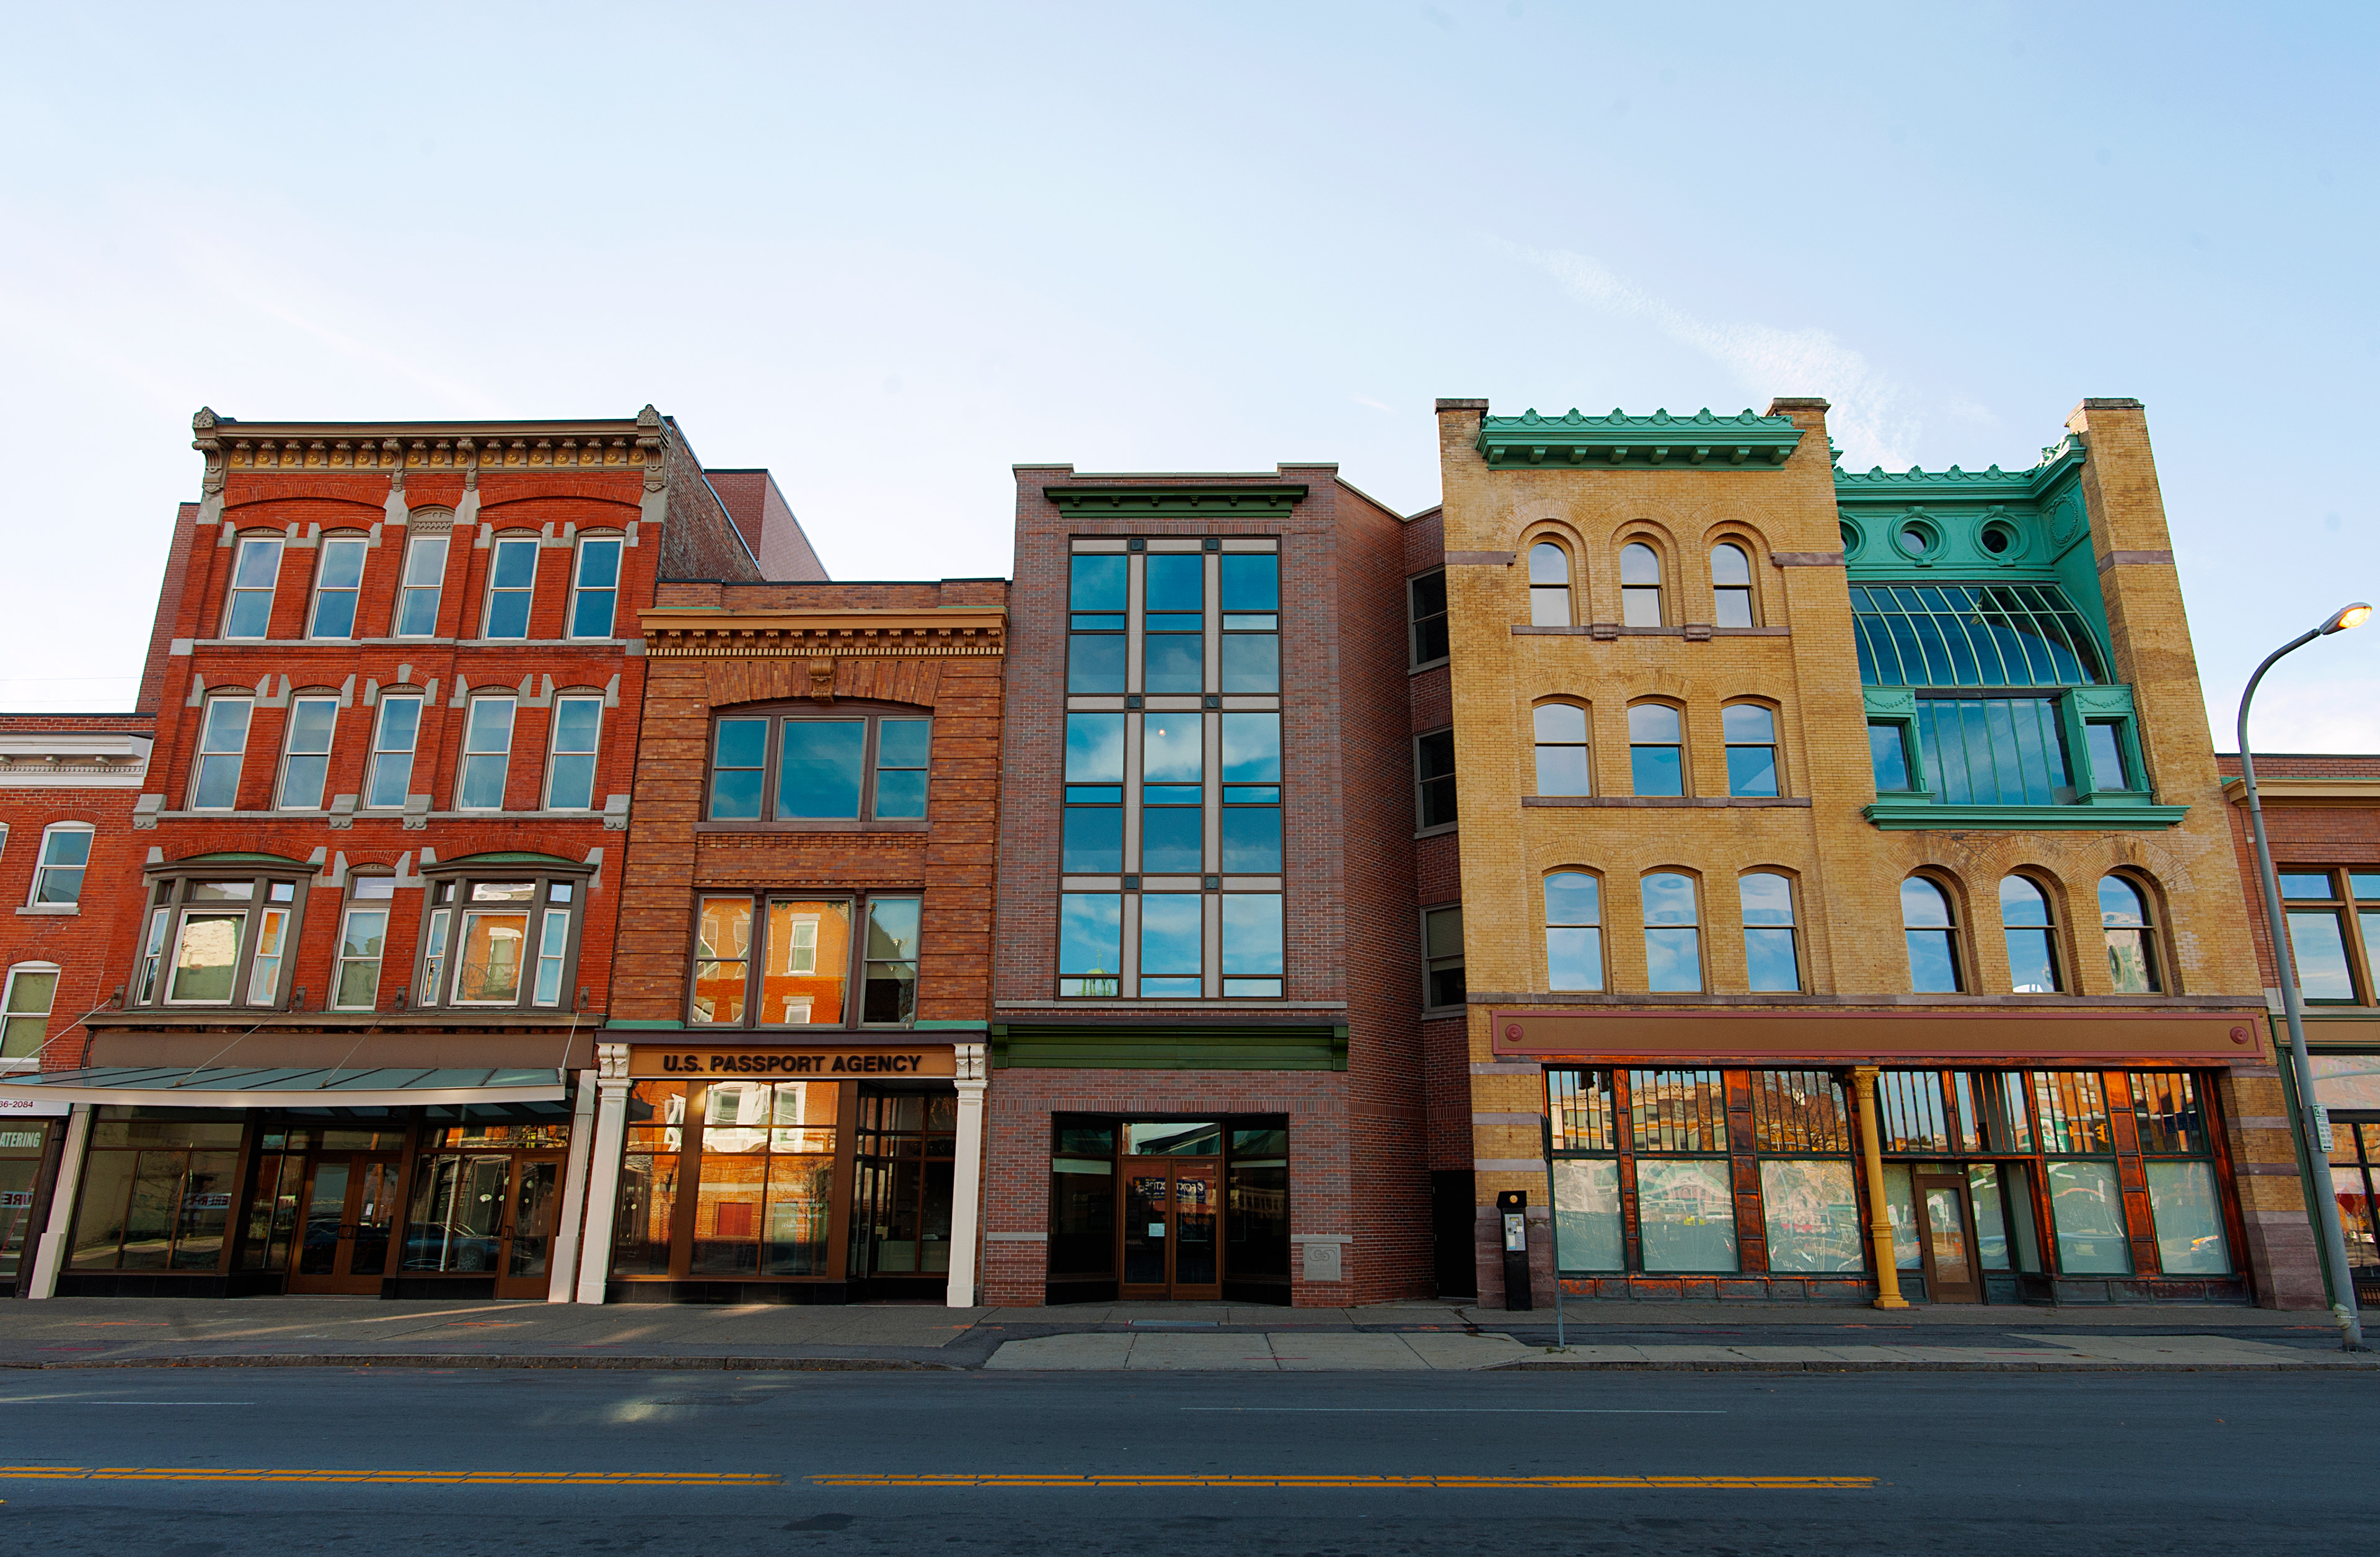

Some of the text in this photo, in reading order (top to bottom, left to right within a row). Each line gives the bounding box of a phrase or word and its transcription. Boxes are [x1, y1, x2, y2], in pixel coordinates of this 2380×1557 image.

[663, 1055, 922, 1072] U.S. PASSPORT AGENCY
[0, 1132, 42, 1147] ATERING
